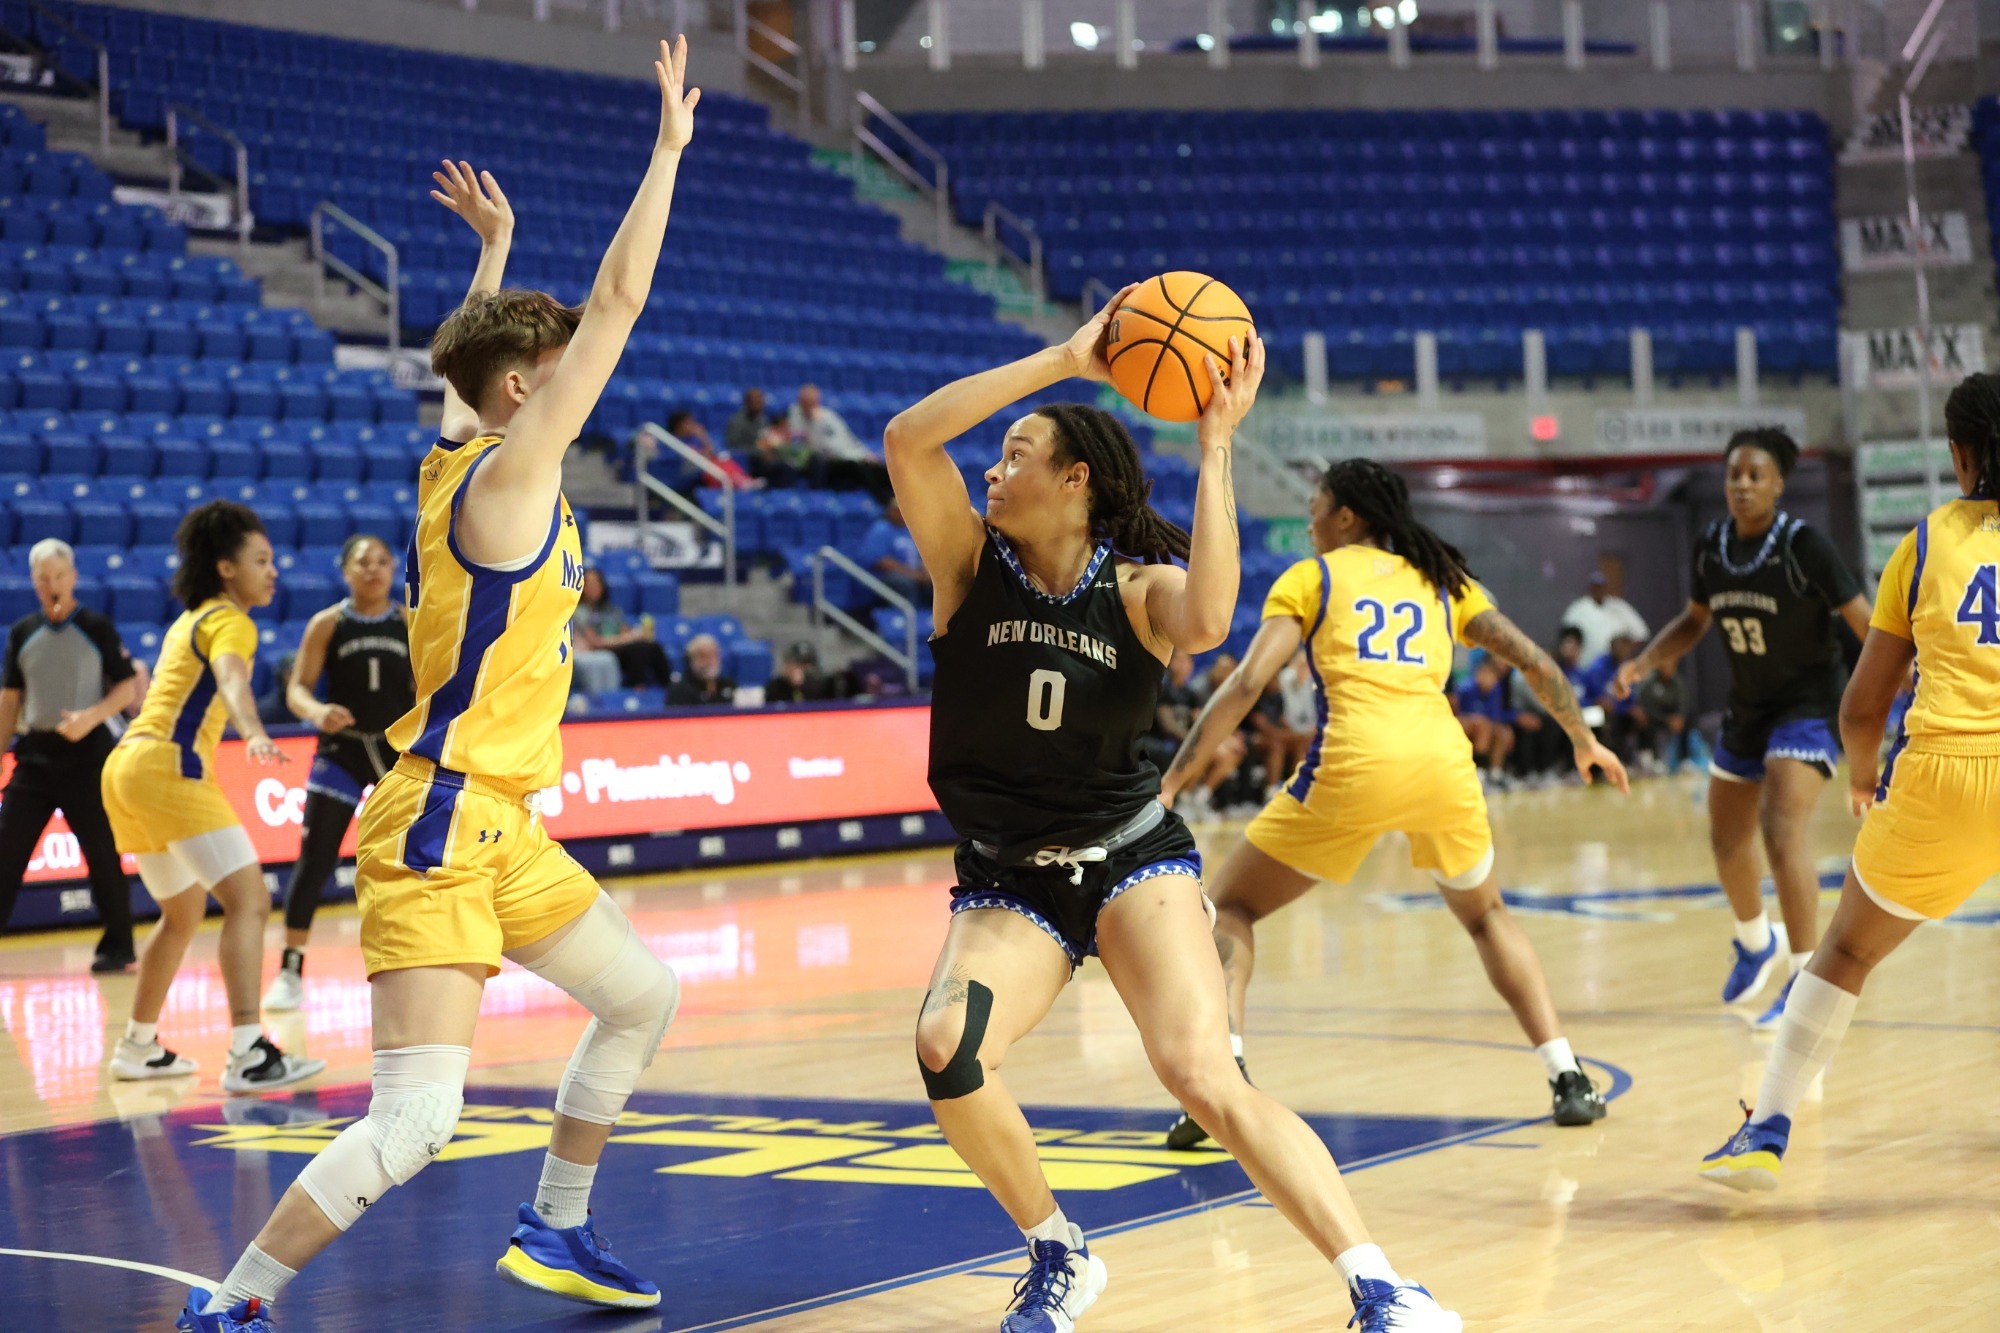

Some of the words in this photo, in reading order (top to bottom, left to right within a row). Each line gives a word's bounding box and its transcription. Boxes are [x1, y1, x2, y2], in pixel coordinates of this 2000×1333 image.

[987, 620, 1028, 647] NEW
[1030, 621, 1118, 670] ORLEANS
[1354, 597, 1426, 666] 22
[1721, 616, 1767, 656] 33
[368, 656, 381, 692] 1
[1026, 668, 1067, 731] 0
[581, 754, 735, 804] Plumbing
